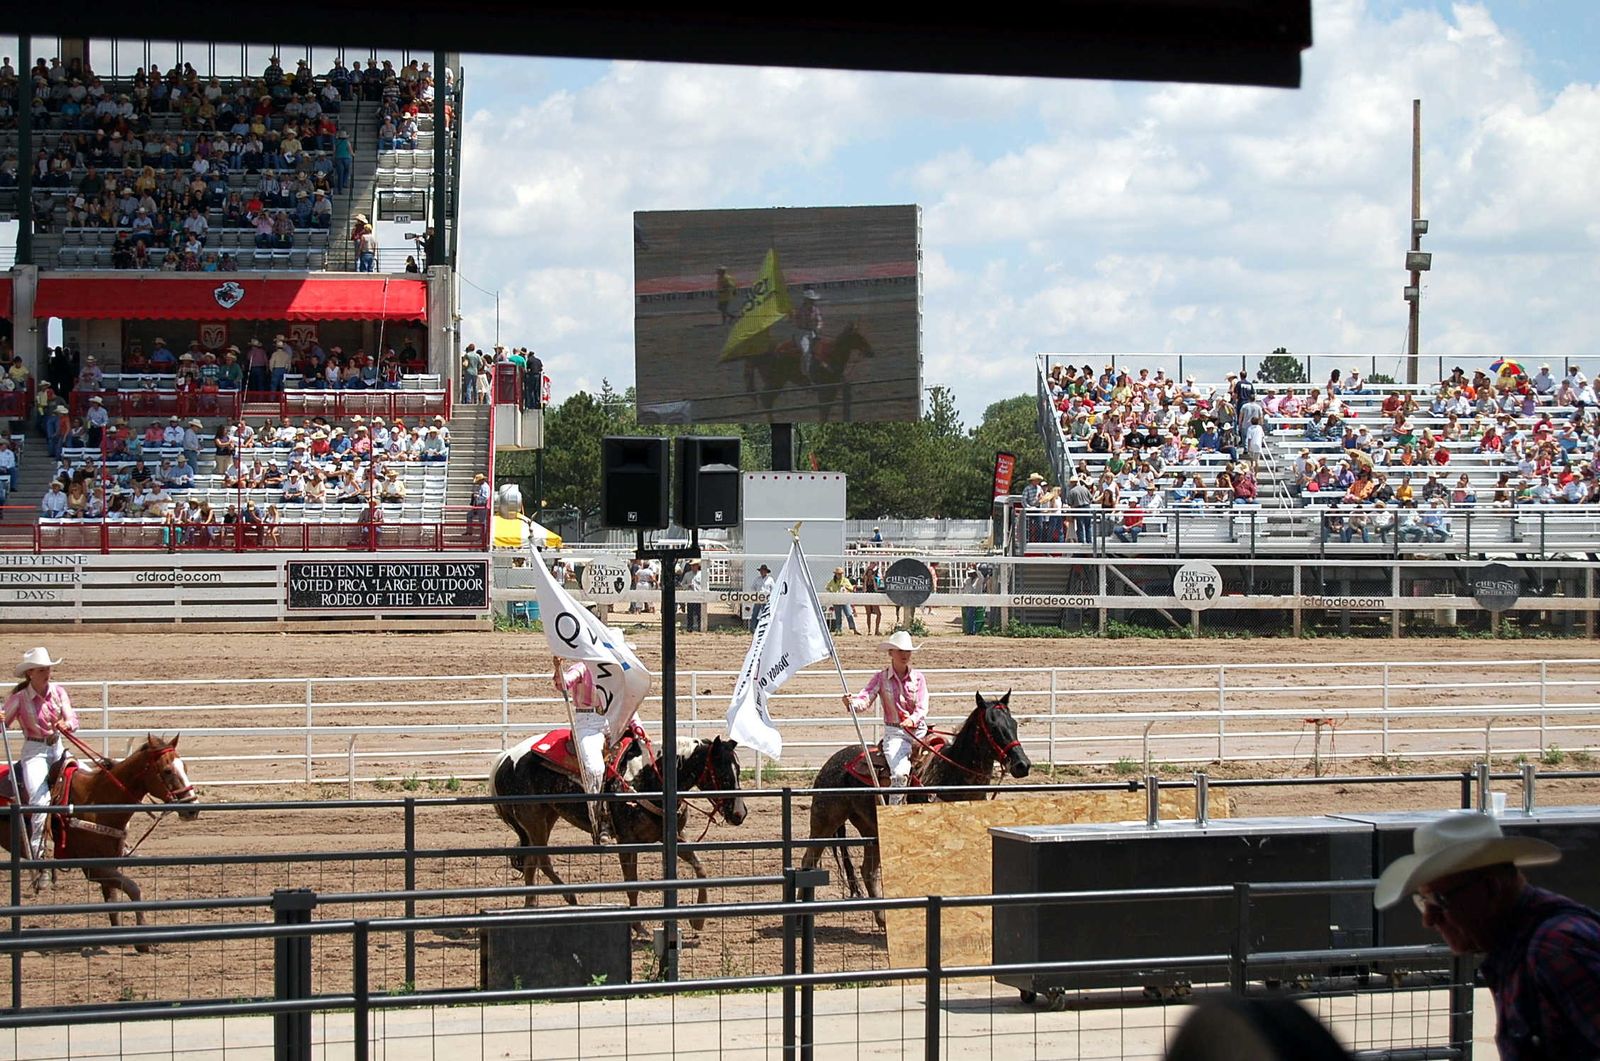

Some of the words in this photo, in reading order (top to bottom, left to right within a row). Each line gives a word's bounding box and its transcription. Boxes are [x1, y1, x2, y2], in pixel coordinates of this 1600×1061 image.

[301, 564, 374, 577] CHEYENNE
[378, 564, 441, 577] FRONTIER
[0, 572, 81, 583] FRONTIER
[136, 571, 222, 582] cfdrodeo.com
[291, 579, 333, 592] VOTED
[337, 579, 368, 592] PRCA
[421, 578, 484, 591] OUTDOOR
[16, 590, 56, 600] DAYS
[321, 593, 362, 606] RODEO
[366, 593, 383, 606] OF
[387, 592, 413, 605] THE
[1012, 595, 1095, 606] cfdrodeo.com
[1303, 597, 1384, 607] cfdrodeo.com
